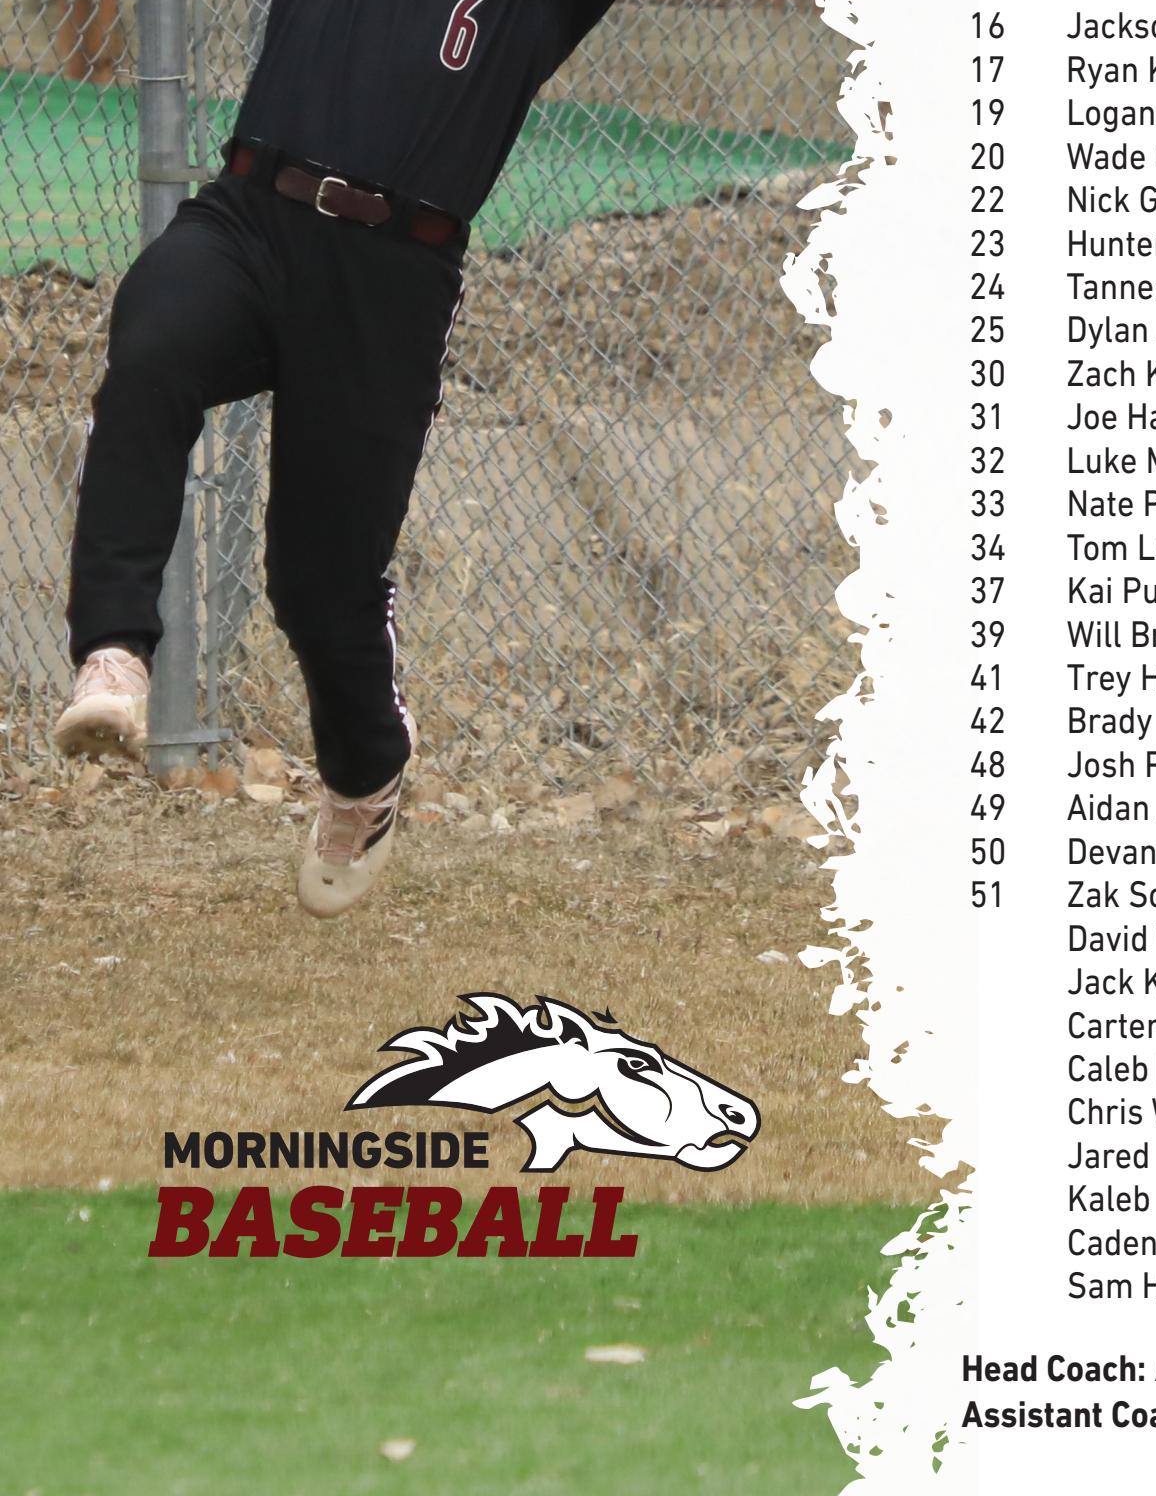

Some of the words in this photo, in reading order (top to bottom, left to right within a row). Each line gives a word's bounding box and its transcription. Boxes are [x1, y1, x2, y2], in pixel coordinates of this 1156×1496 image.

[972, 11, 1005, 39] 16
[972, 98, 1005, 126] 19
[1068, 98, 1155, 133] Logan
[971, 229, 1004, 257] 23
[970, 359, 1005, 387] 30
[1067, 359, 1135, 387] Zach
[970, 446, 1004, 474] 32
[1068, 446, 1137, 474] Luke
[971, 576, 1005, 604] 37
[1068, 576, 1112, 604] Kai
[970, 706, 1005, 734] 42
[1068, 706, 1153, 741] Brady
[970, 793, 1005, 821] 49
[1067, 793, 1149, 821] Aidan
[1069, 924, 1147, 952] David
[1068, 1054, 1148, 1082] Caleb
[164, 1131, 489, 1169] MORNINGSIDE
[1067, 1141, 1149, 1169] Jared
[148, 1185, 638, 1259] BASEBALL
[1068, 1271, 1132, 1299] Sam
[962, 1354, 1037, 1383] Head
[1047, 1354, 1145, 1382] Coach:
[961, 1400, 1103, 1428] Assistant
